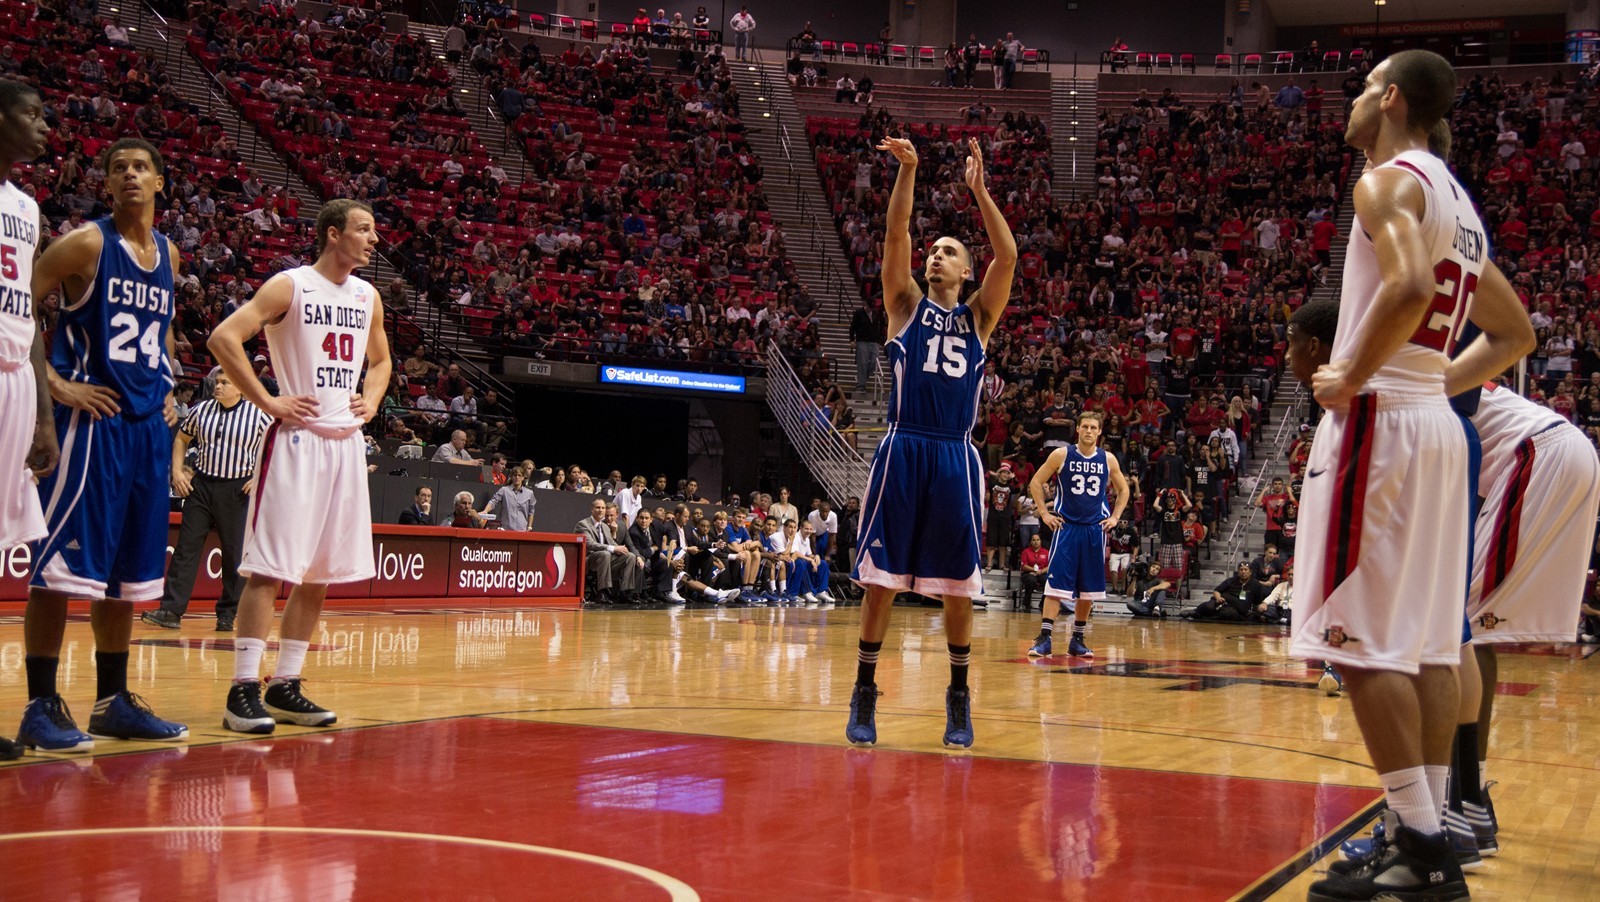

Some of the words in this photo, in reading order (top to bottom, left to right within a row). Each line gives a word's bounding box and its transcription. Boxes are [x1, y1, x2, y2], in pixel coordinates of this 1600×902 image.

[1352, 25, 1400, 35] Restrooms
[1403, 22, 1461, 33] Concessions
[1463, 20, 1500, 30] Outside
[710, 32, 719, 42] N
[792, 38, 802, 49] M
[1037, 51, 1047, 61] M
[1103, 52, 1113, 62] M
[1363, 49, 1373, 60] M
[1454, 46, 1463, 57] L
[1, 213, 36, 248] DIEGO
[1, 244, 19, 281] 5
[107, 277, 170, 316] CSUSM
[304, 304, 333, 326] SAN
[336, 306, 367, 330] DIEGO
[921, 307, 971, 335] CSUM
[108, 311, 161, 370] 24
[321, 332, 355, 363] 40
[922, 334, 968, 379] 15
[530, 364, 549, 375] EXIT
[616, 369, 680, 386] SafeList.com
[316, 367, 354, 391] STATE
[1069, 461, 1104, 475] CSUSM
[1197, 471, 1208, 479] 22
[1070, 474, 1102, 497] 33
[377, 543, 425, 581] love
[461, 545, 511, 563] Qualcomm
[458, 564, 543, 593] snapdragon
[1429, 871, 1443, 882] 23
